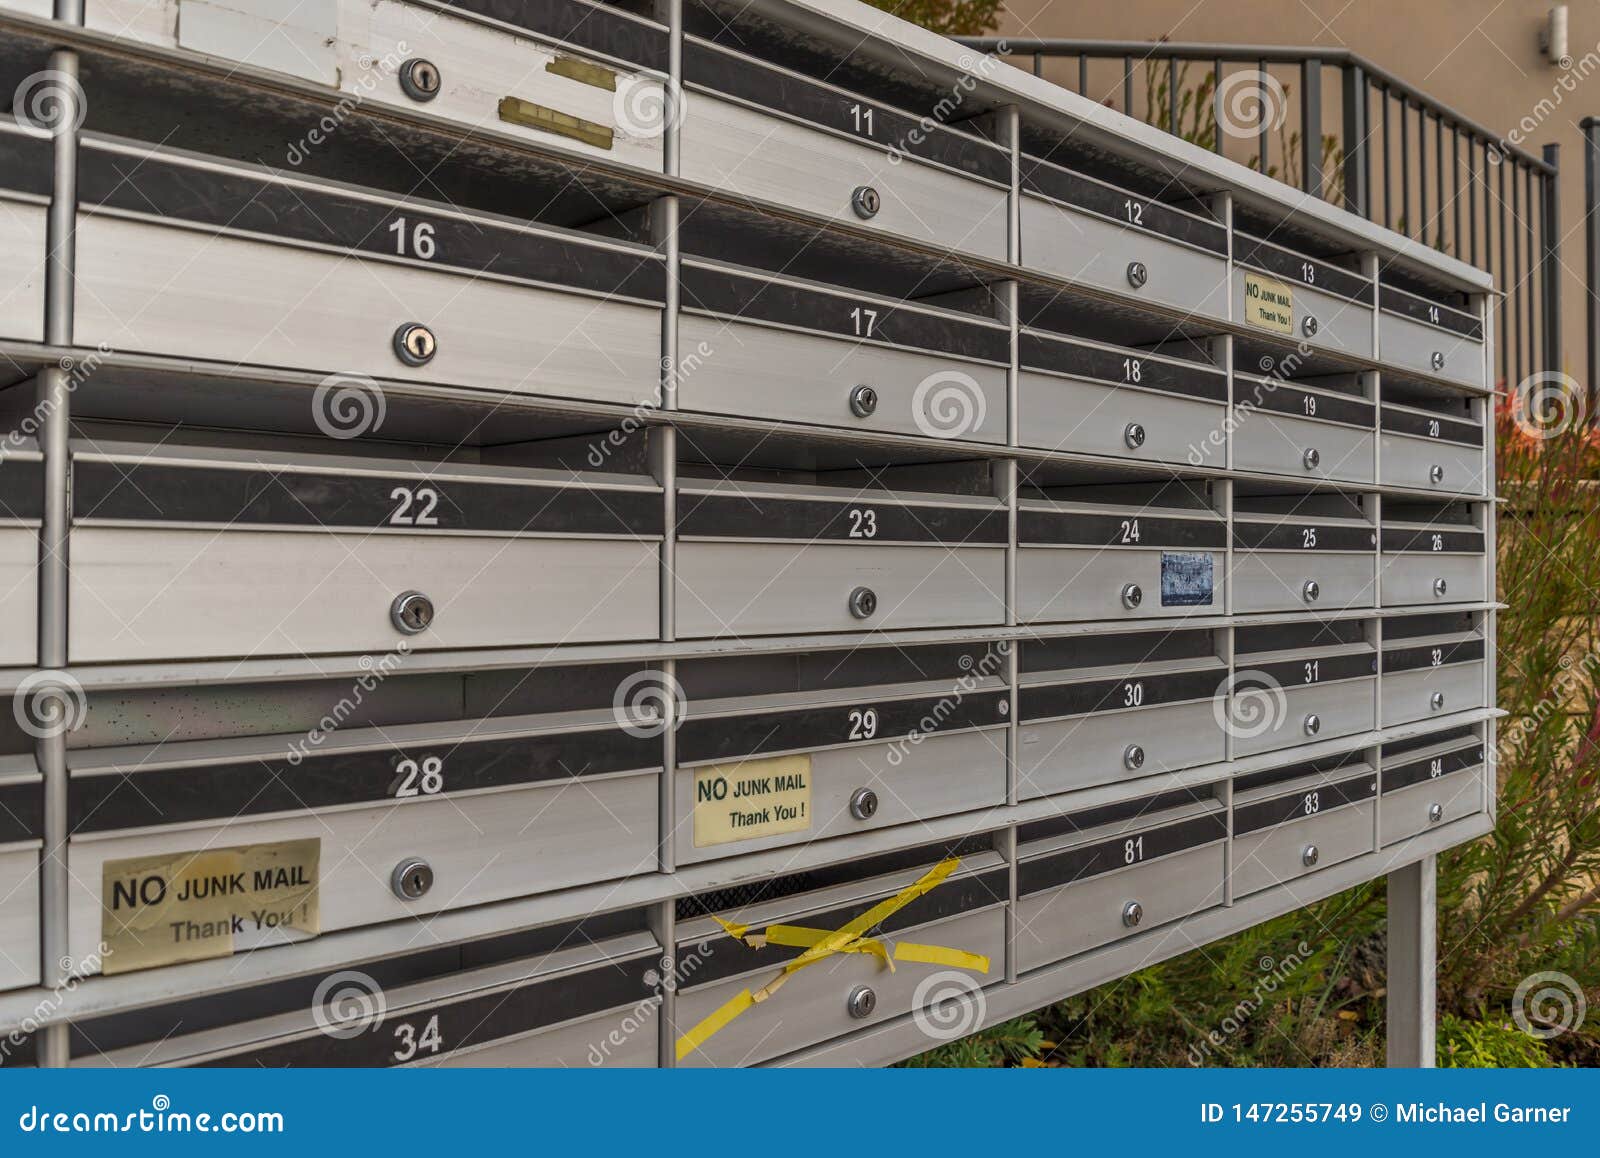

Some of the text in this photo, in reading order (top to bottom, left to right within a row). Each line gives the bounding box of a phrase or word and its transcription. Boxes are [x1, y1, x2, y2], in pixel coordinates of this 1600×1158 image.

[850, 104, 874, 137] 11
[1124, 199, 1143, 226] 12
[389, 218, 435, 259] 16
[1301, 262, 1314, 283] 13
[1246, 282, 1259, 298] NO
[851, 308, 877, 337] 17
[1259, 307, 1276, 322] Thank
[1276, 312, 1288, 325] You
[1428, 306, 1439, 324] 14
[1123, 358, 1141, 383] 18
[1303, 396, 1316, 416] 19
[1428, 419, 1440, 438] 20
[390, 487, 439, 525] 22
[849, 509, 877, 538] 23
[1121, 520, 1140, 544] 24
[1302, 527, 1316, 548] 25
[1431, 534, 1443, 551] 26
[1431, 649, 1443, 666] 32
[1304, 661, 1319, 683] 31
[1124, 682, 1143, 707] 30
[849, 710, 877, 740] 29
[395, 757, 443, 798] 28
[1430, 758, 1442, 778] 84
[698, 774, 806, 803] NO JUNK MAIL
[1304, 792, 1319, 815] 83
[729, 808, 770, 828] Thank
[774, 805, 796, 821] You
[1124, 836, 1143, 864] 81
[113, 865, 310, 910] NO JUNK MAIL
[170, 914, 244, 943] Thank
[251, 908, 293, 930] You
[394, 1015, 442, 1060] 34
